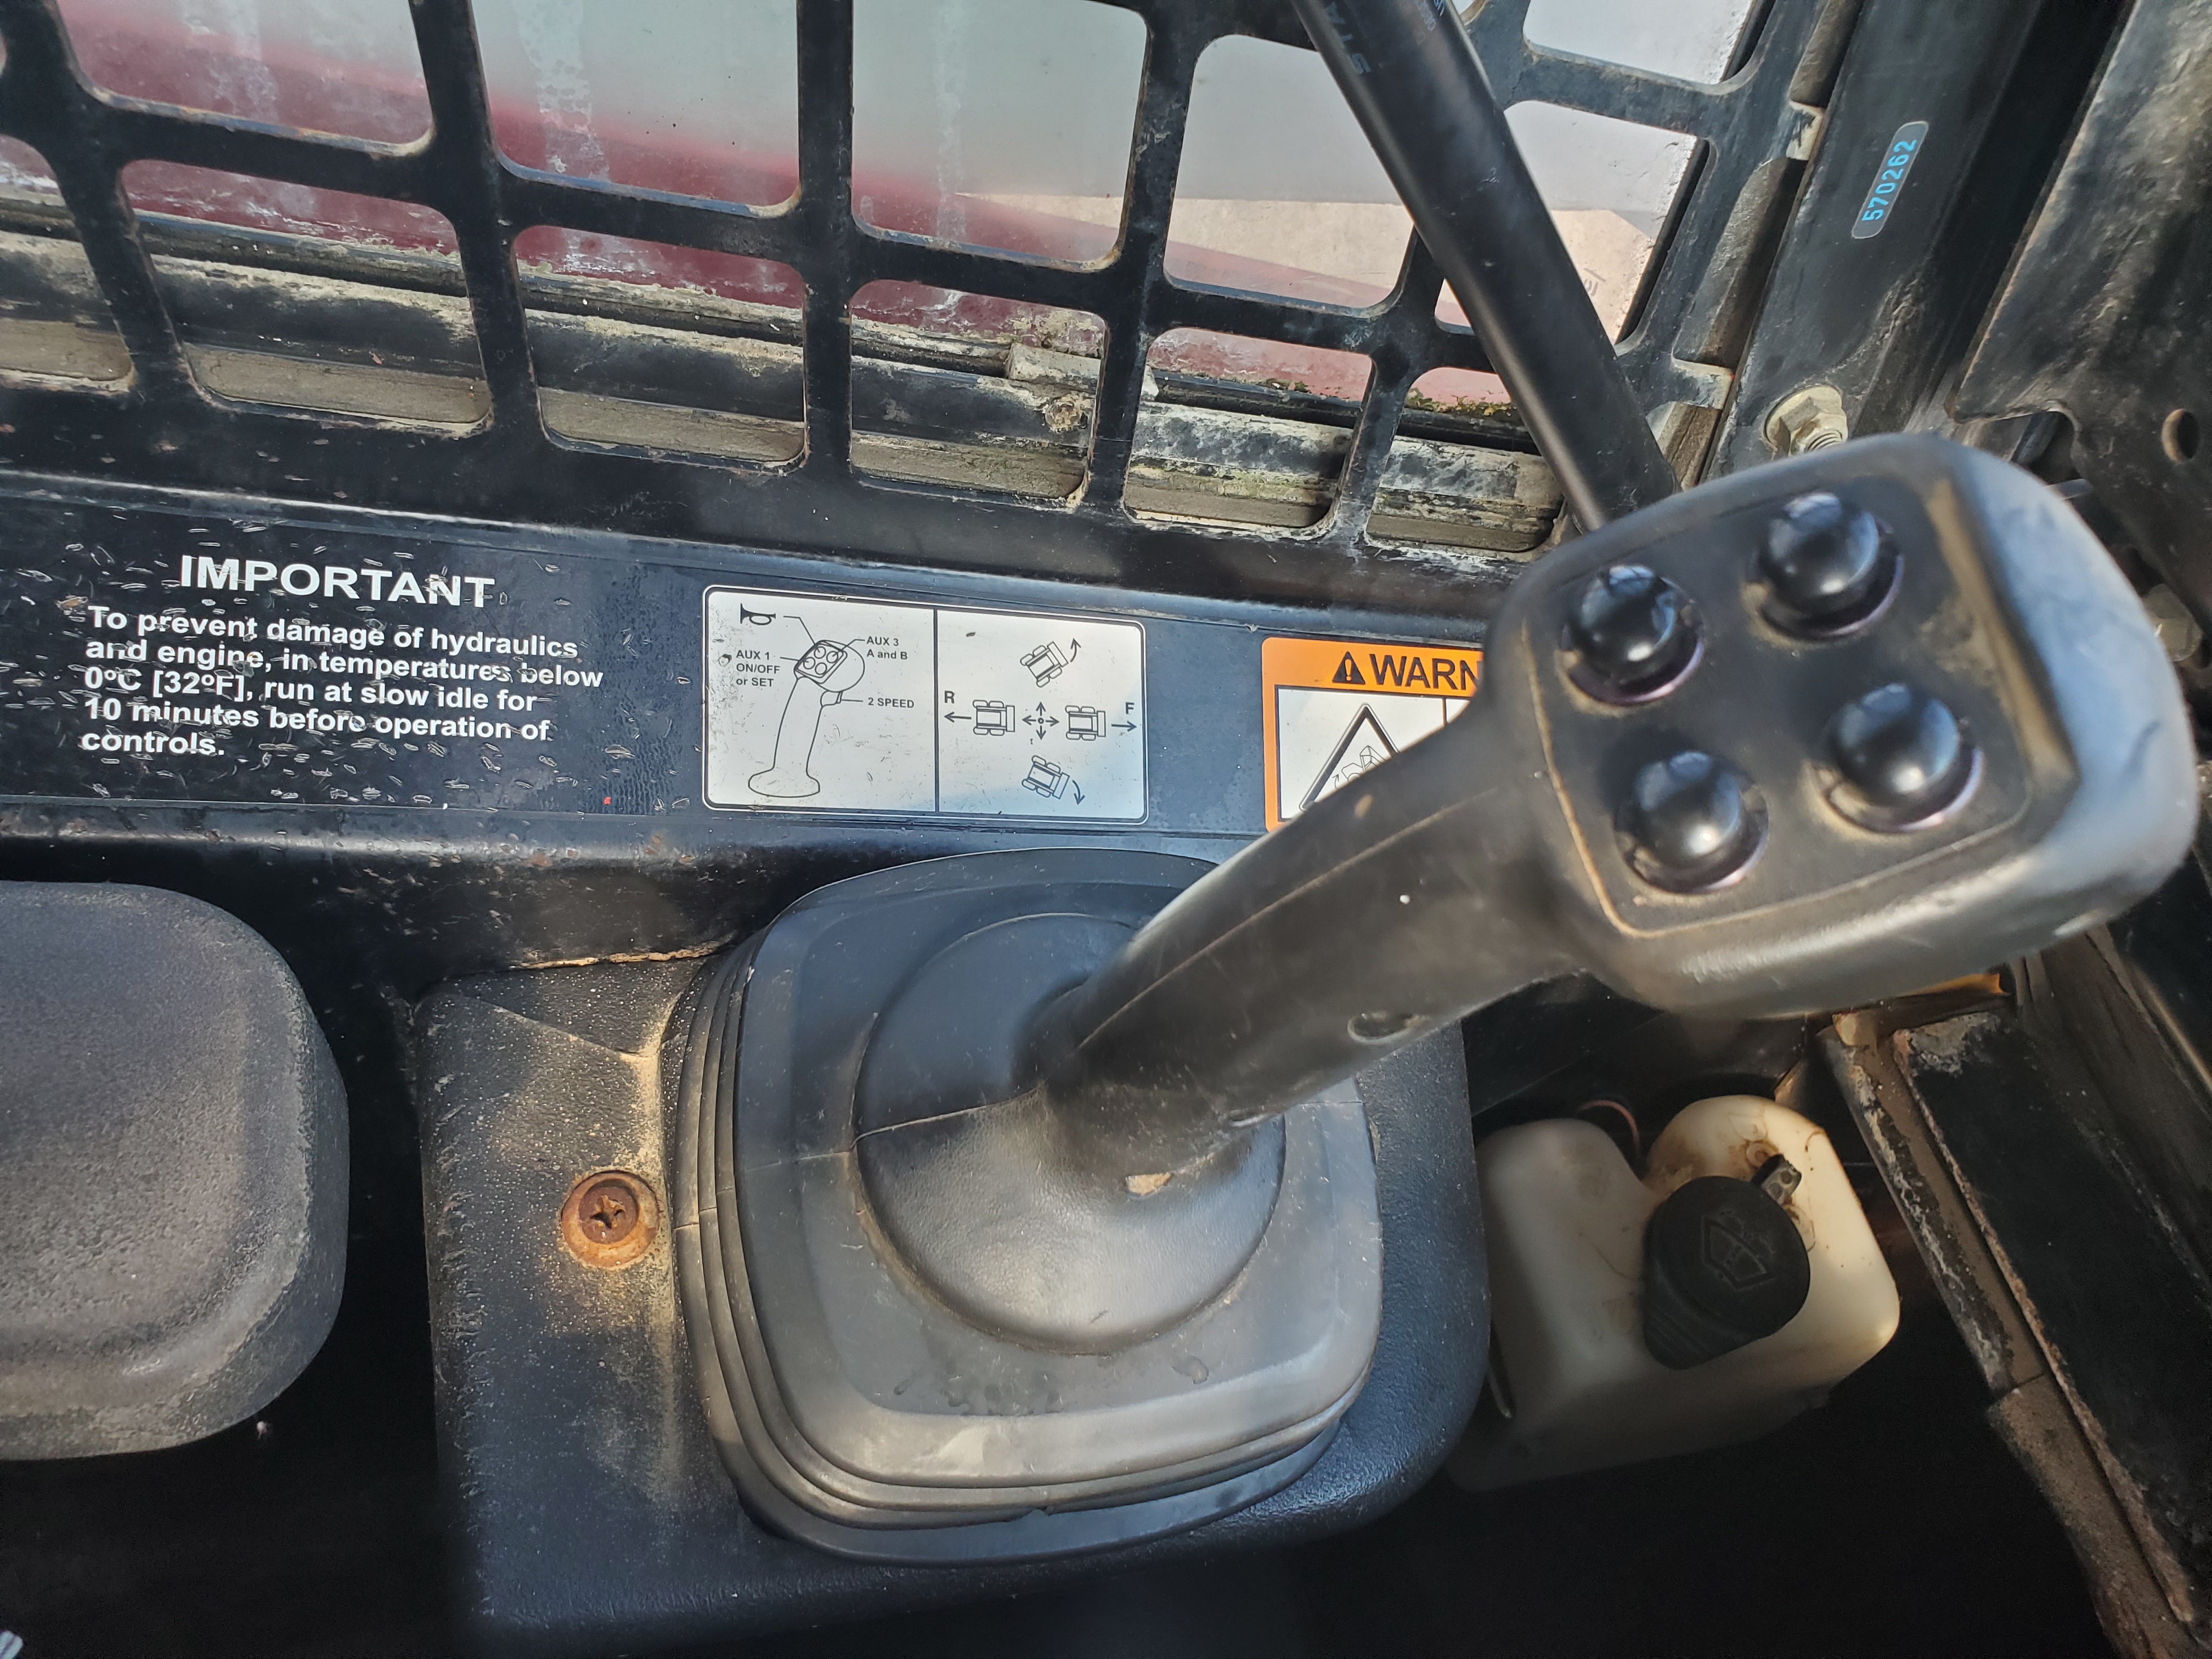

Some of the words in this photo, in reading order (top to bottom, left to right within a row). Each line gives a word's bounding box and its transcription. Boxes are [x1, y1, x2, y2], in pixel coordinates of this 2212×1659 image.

[1861, 140, 1917, 221] 570262
[180, 555, 495, 607] IMPORTANT
[88, 605, 127, 629] To
[138, 611, 258, 640] prevent
[266, 618, 384, 648] damage
[393, 625, 422, 649] of
[431, 629, 578, 658] hydraulics
[866, 636, 889, 645] AUX
[893, 638, 899, 646] 3
[736, 650, 760, 659] AUX
[867, 650, 874, 658] A
[877, 650, 896, 659] and
[86, 639, 146, 663] and
[157, 642, 272, 673] engine,
[282, 647, 309, 671] in
[319, 651, 511, 682] temperatures
[520, 662, 603, 688] below
[736, 664, 780, 674] ON/OFF
[751, 678, 774, 687] SET
[264, 681, 314, 702] run
[325, 682, 352, 703] at
[362, 683, 427, 707] slow
[438, 686, 488, 709] idle
[497, 689, 537, 712] for
[868, 697, 874, 706] 2
[877, 698, 915, 708] SPEED
[944, 691, 955, 703] R
[1126, 702, 1135, 714] F
[85, 698, 122, 721] 10
[132, 701, 259, 727] minutes
[270, 708, 365, 732] before
[375, 715, 511, 740] operation
[522, 719, 550, 742] of
[81, 730, 224, 757] controls.
